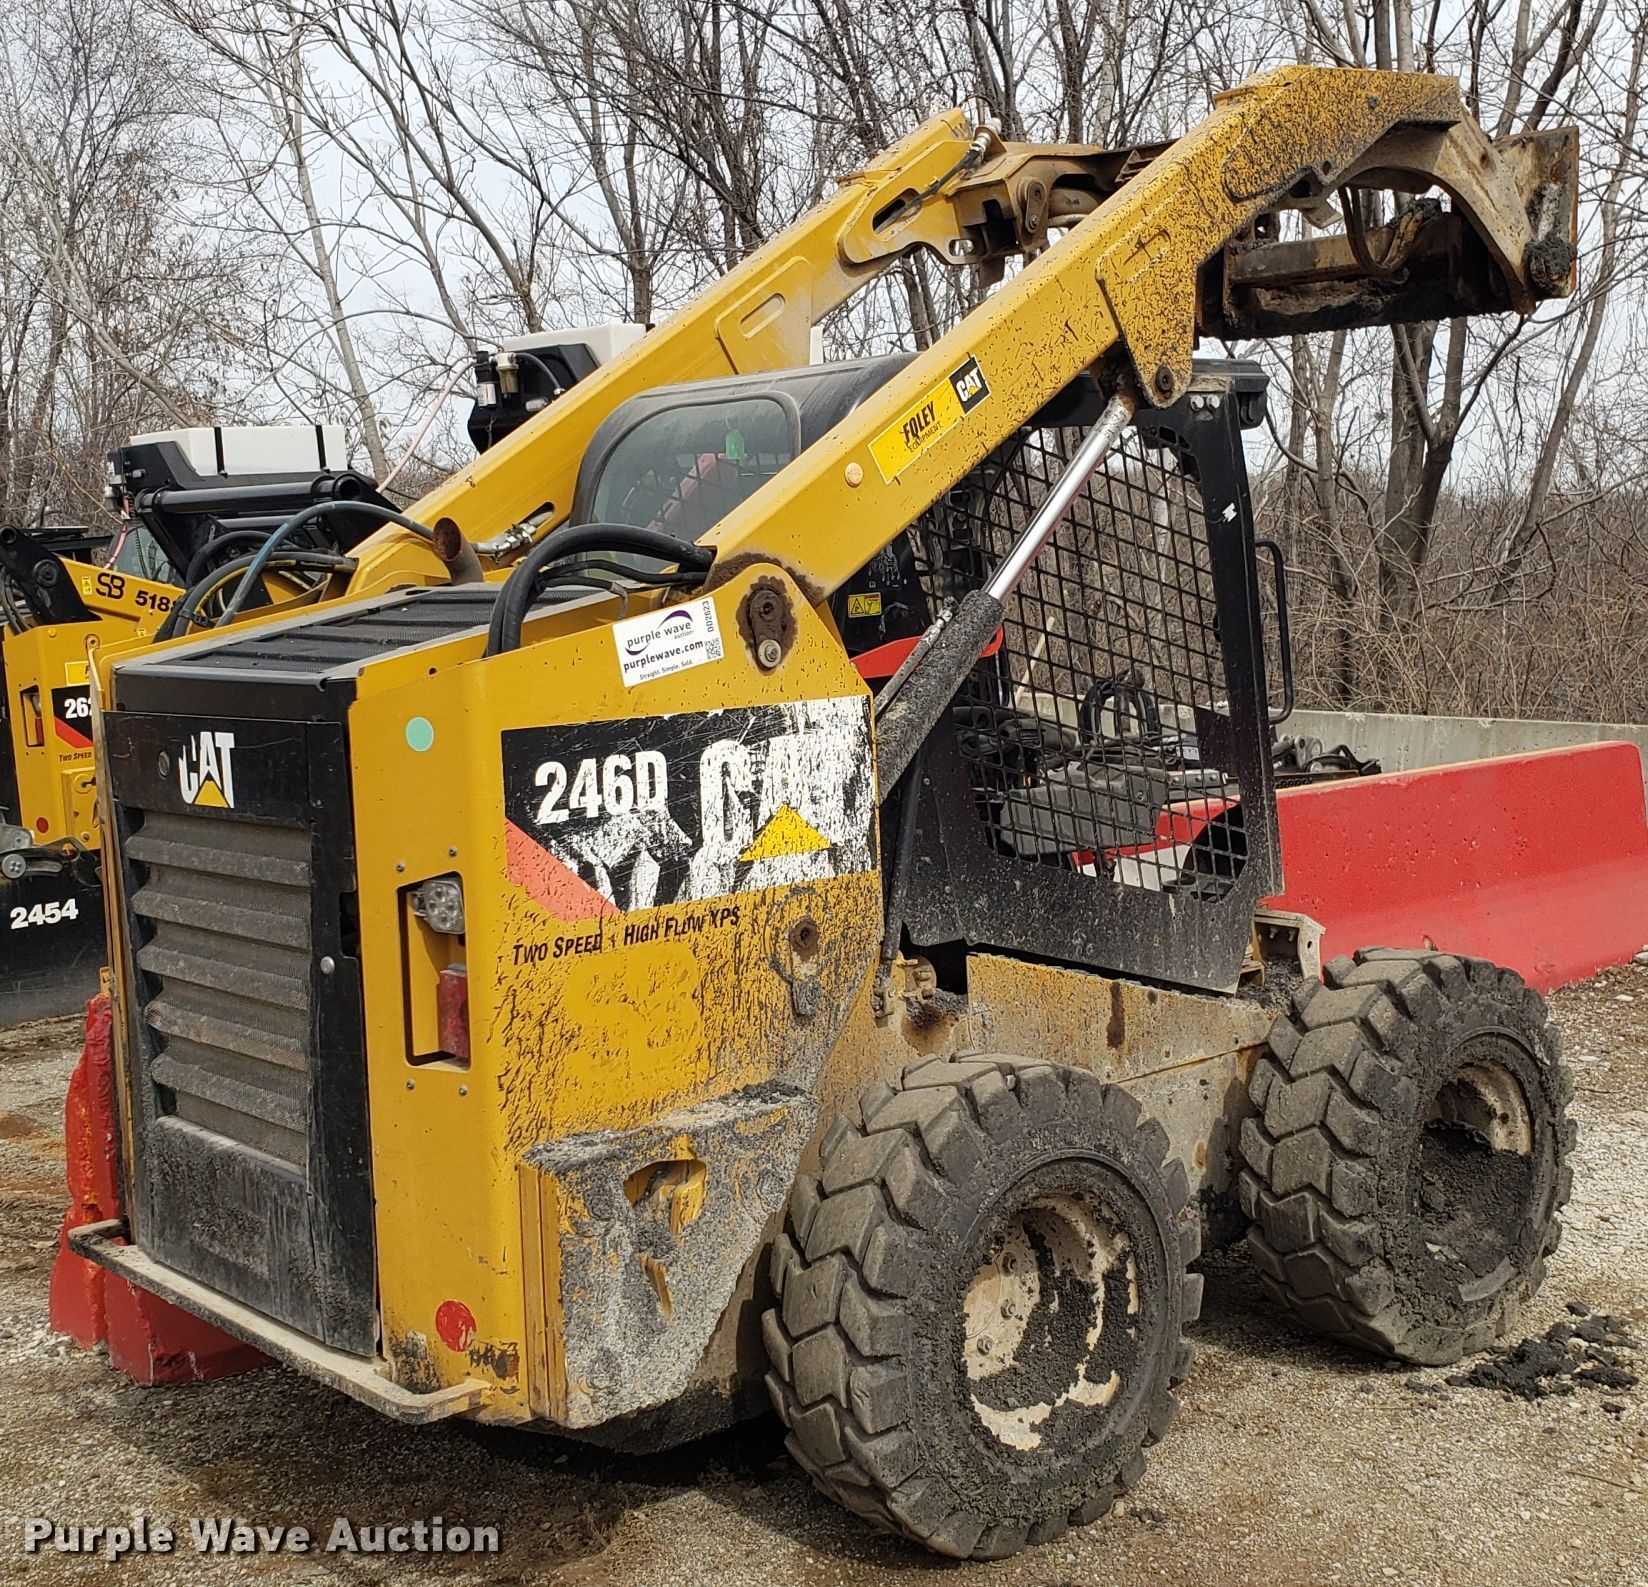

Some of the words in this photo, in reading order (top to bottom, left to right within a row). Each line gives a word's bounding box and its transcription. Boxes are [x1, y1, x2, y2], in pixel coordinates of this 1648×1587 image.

[956, 367, 983, 402] CAT
[902, 401, 936, 443] FOLEY
[96, 572, 126, 600] SB
[135, 590, 177, 612] 518
[702, 600, 714, 633] DD2623
[627, 629, 661, 649] purple
[664, 621, 691, 637] wave
[623, 640, 704, 673] purplewave.com
[73, 751, 92, 760] SPEED
[178, 731, 236, 809] CAT
[535, 750, 668, 825] 246D
[10, 899, 79, 930] 2454
[552, 933, 601, 958] SPEED
[624, 923, 659, 945] HIGH
